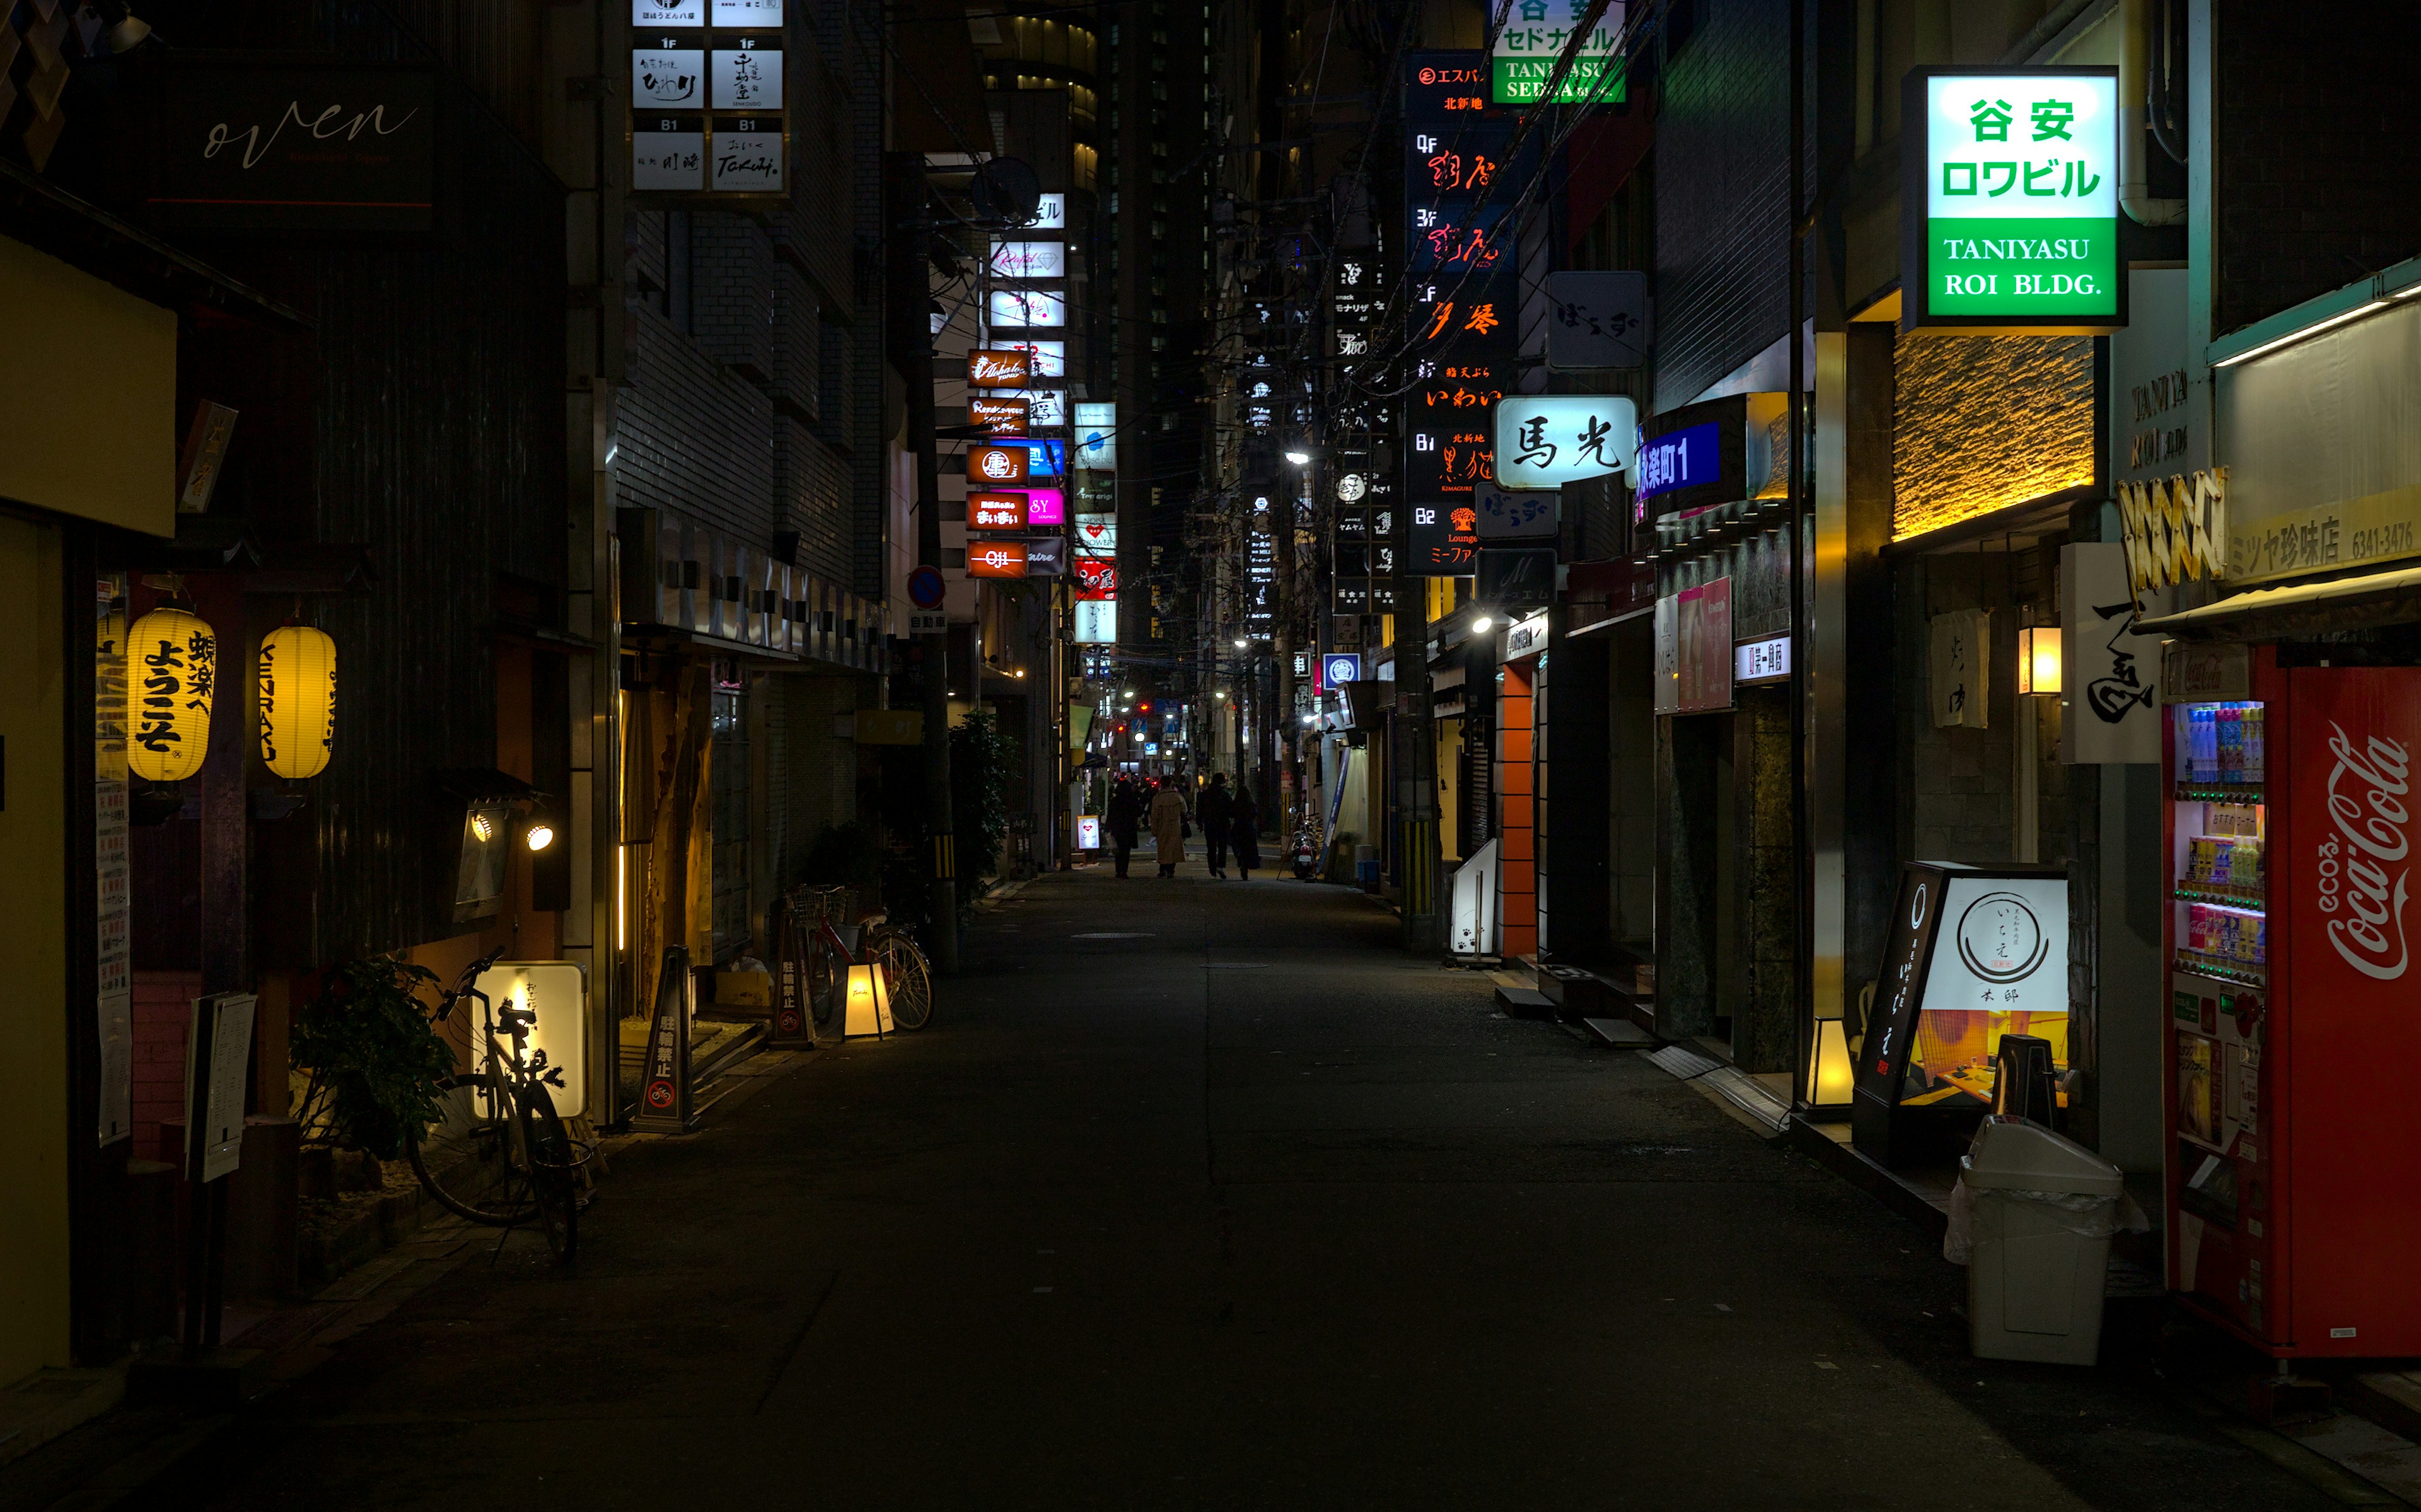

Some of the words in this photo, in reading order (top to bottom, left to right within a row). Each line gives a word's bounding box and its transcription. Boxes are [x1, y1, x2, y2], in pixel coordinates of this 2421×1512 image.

[661, 37, 677, 49] 1F
[740, 37, 755, 49] 1F
[1504, 28, 1614, 51] セドナル
[1438, 69, 1483, 83] エスパ
[1444, 97, 1483, 110] 北新地
[661, 119, 677, 131] B1
[739, 119, 755, 131] B1
[1970, 98, 2074, 142] 谷安
[204, 101, 418, 169] oven
[1943, 158, 2101, 198] ロワビル
[1417, 209, 1437, 227] 3F
[1943, 238, 2089, 260] TANIYASU
[1944, 274, 1997, 295] ROI
[2013, 274, 2101, 295] BLDG.
[1335, 304, 1369, 312] モナリザ
[1415, 434, 1434, 451] B1
[1453, 434, 1485, 443] 北新地
[1513, 415, 1621, 468] 馬光
[977, 511, 1018, 524] まいまい
[1415, 507, 1436, 524] B2
[1448, 534, 1478, 544] Lounge
[2231, 516, 2340, 575] ミツヤ珍味店
[2352, 521, 2413, 560] 6341-3476
[1432, 547, 1482, 563] ミーファ
[911, 616, 946, 628] 自動車
[136, 640, 183, 752] ようこそ
[2327, 719, 2410, 980] Coca-Cola
[1995, 908, 2010, 958] いちえ
[656, 1015, 675, 1078] 駐輪禁止
